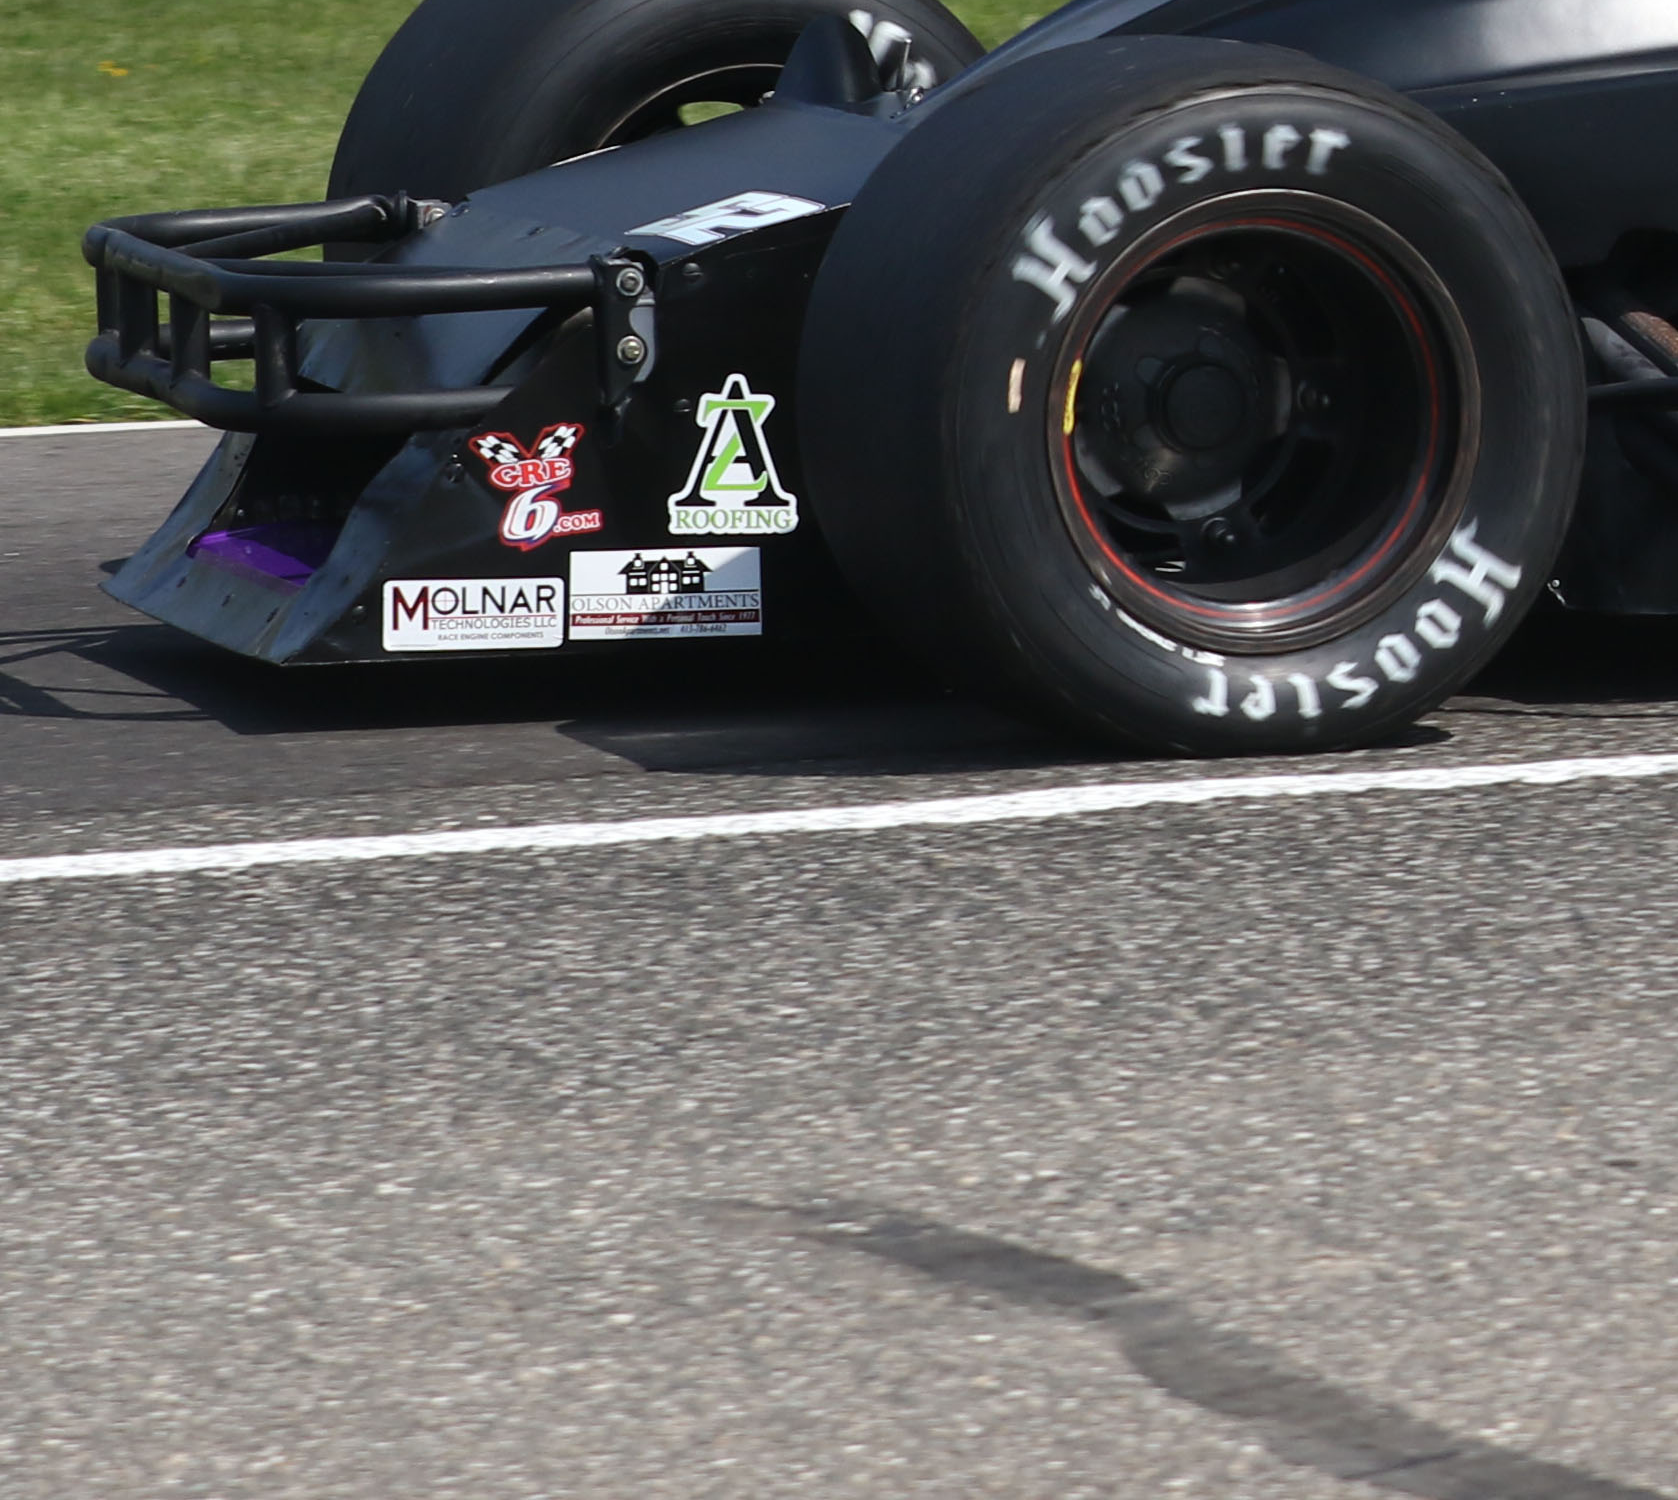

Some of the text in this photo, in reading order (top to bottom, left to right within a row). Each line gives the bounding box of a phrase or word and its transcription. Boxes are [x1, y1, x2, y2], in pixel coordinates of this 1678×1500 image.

[1011, 123, 1351, 324] Hoosier
[491, 458, 571, 487] GRE
[675, 509, 792, 529] ROOFING
[392, 584, 557, 631] MOLNAR
[571, 592, 760, 612] OLSON APARTMENTS
[431, 616, 557, 631] TECHNOLOGIES LLC
[1193, 516, 1523, 721] Hoosier
[490, 631, 545, 640] COMPONENTS
